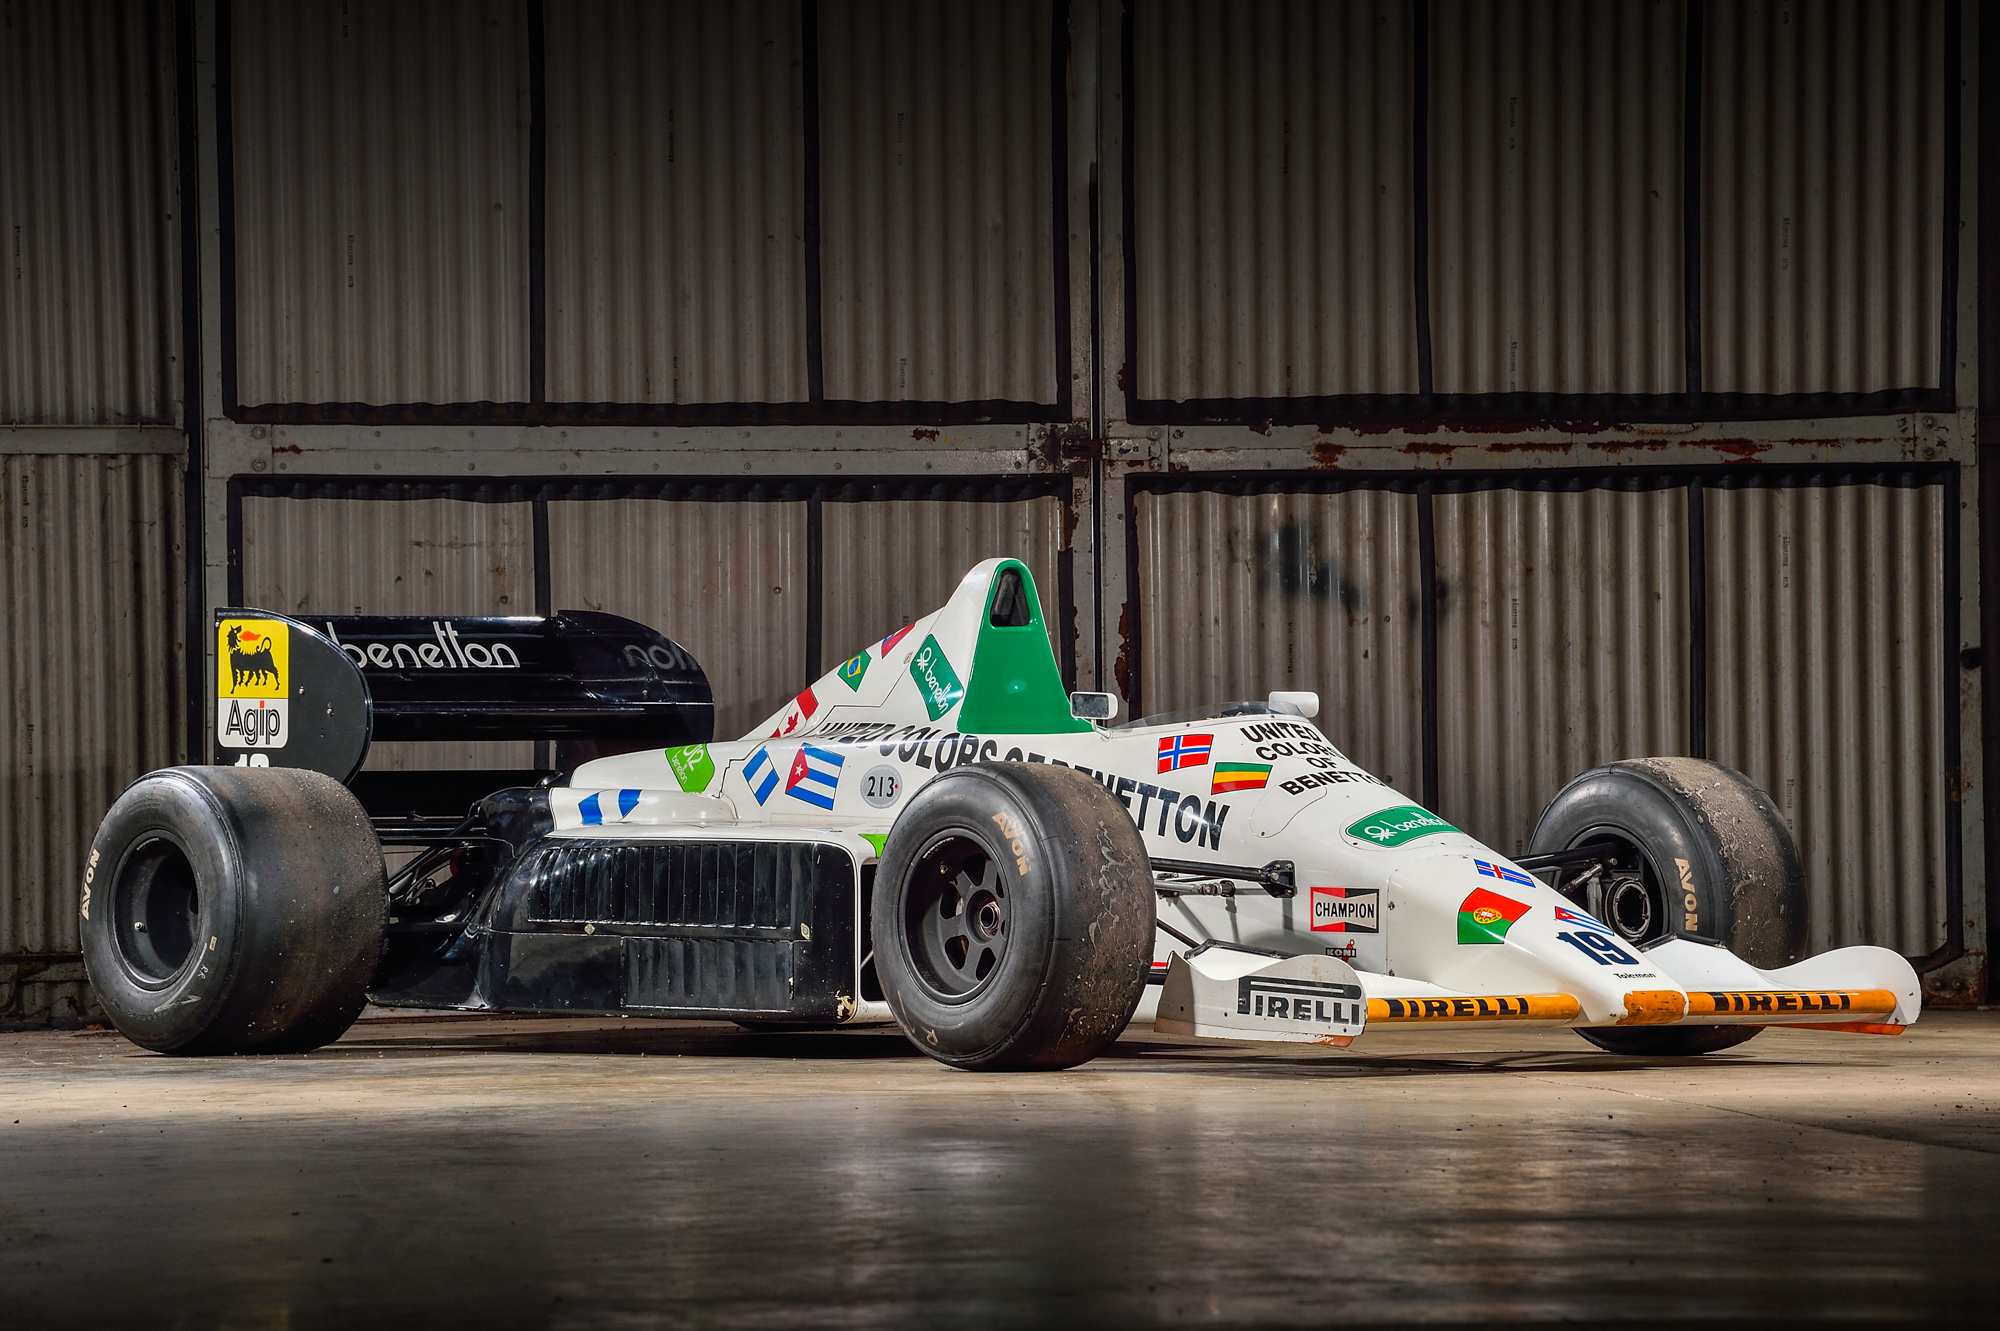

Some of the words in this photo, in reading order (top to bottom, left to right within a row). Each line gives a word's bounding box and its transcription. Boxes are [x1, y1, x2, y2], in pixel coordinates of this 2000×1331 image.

[326, 621, 521, 668] benetton
[925, 658, 952, 714] benetton
[225, 699, 281, 746] Agip
[1239, 722, 1323, 743] UNITED
[1306, 756, 1338, 769] OF
[867, 776, 895, 798] 213
[991, 811, 1032, 876] AVON
[81, 848, 101, 921] AVON
[1674, 857, 1698, 932] AVON
[1315, 901, 1375, 919] CHAMPION
[1327, 949, 1356, 957] KONI
[1555, 932, 1640, 966] 19
[1613, 972, 1657, 980] Toleman
[1237, 976, 1362, 1026] PIRELLI
